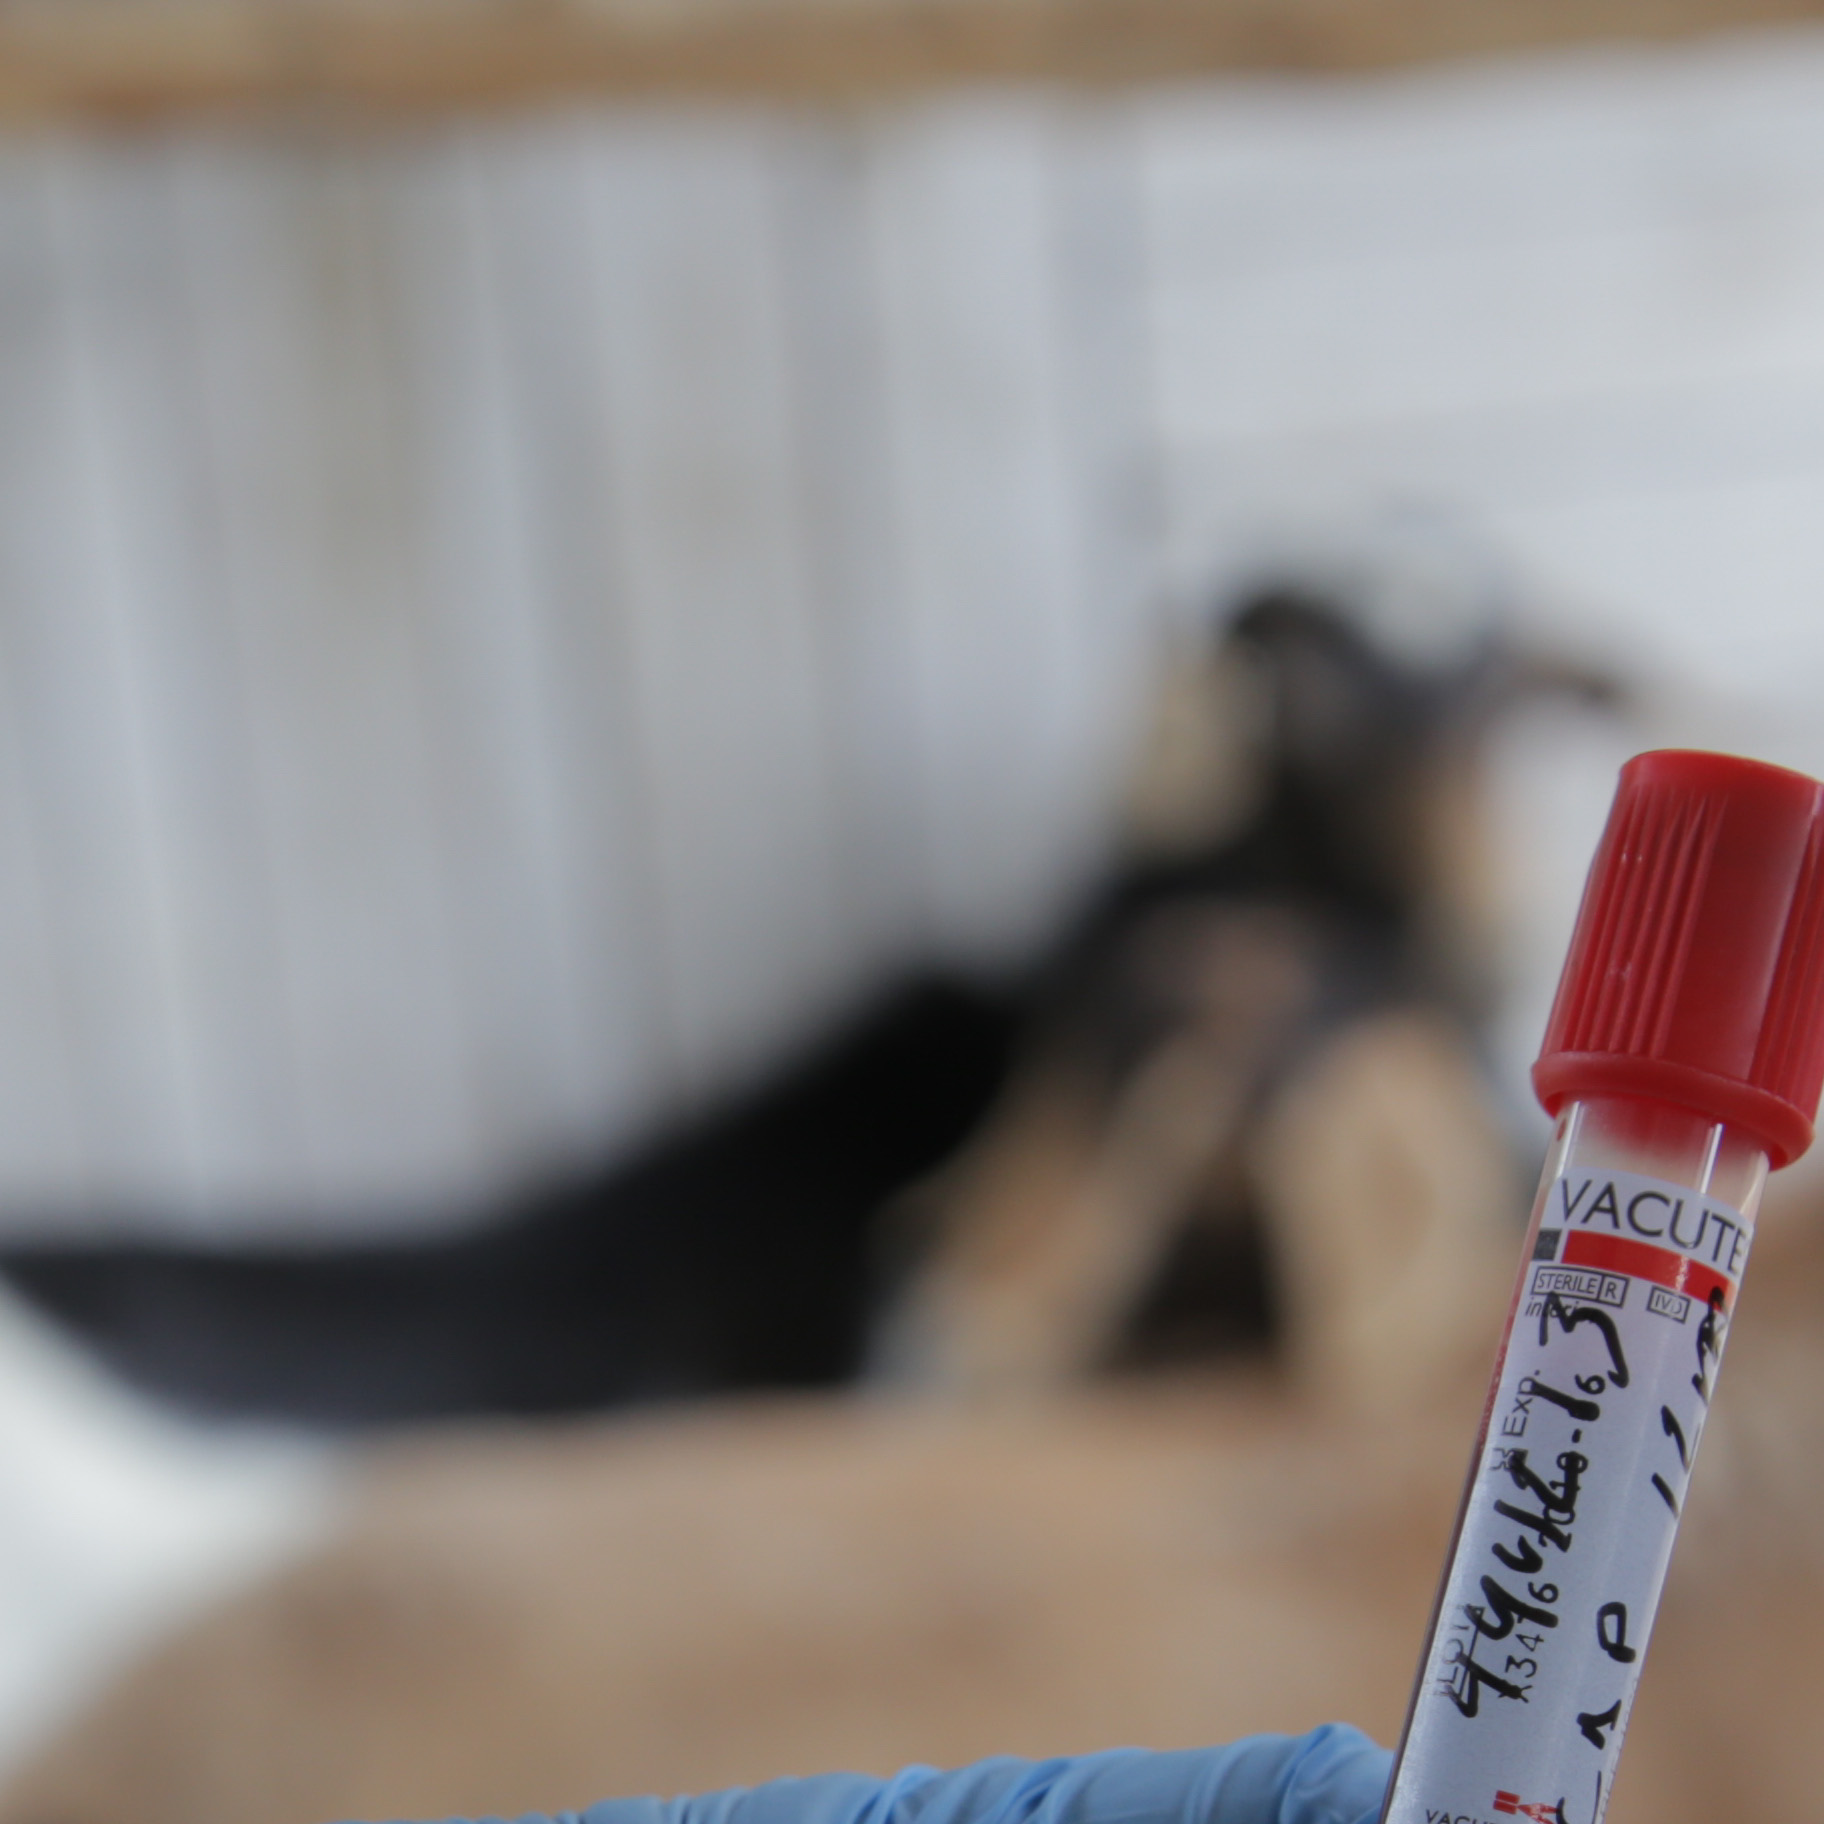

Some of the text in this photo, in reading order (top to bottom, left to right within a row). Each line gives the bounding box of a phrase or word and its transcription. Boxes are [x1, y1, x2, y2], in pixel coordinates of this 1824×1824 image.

[1535, 1272, 1619, 1300] STERILE R
[1652, 1291, 1685, 1316] IVD
[1502, 1369, 1541, 1437] Exp.
